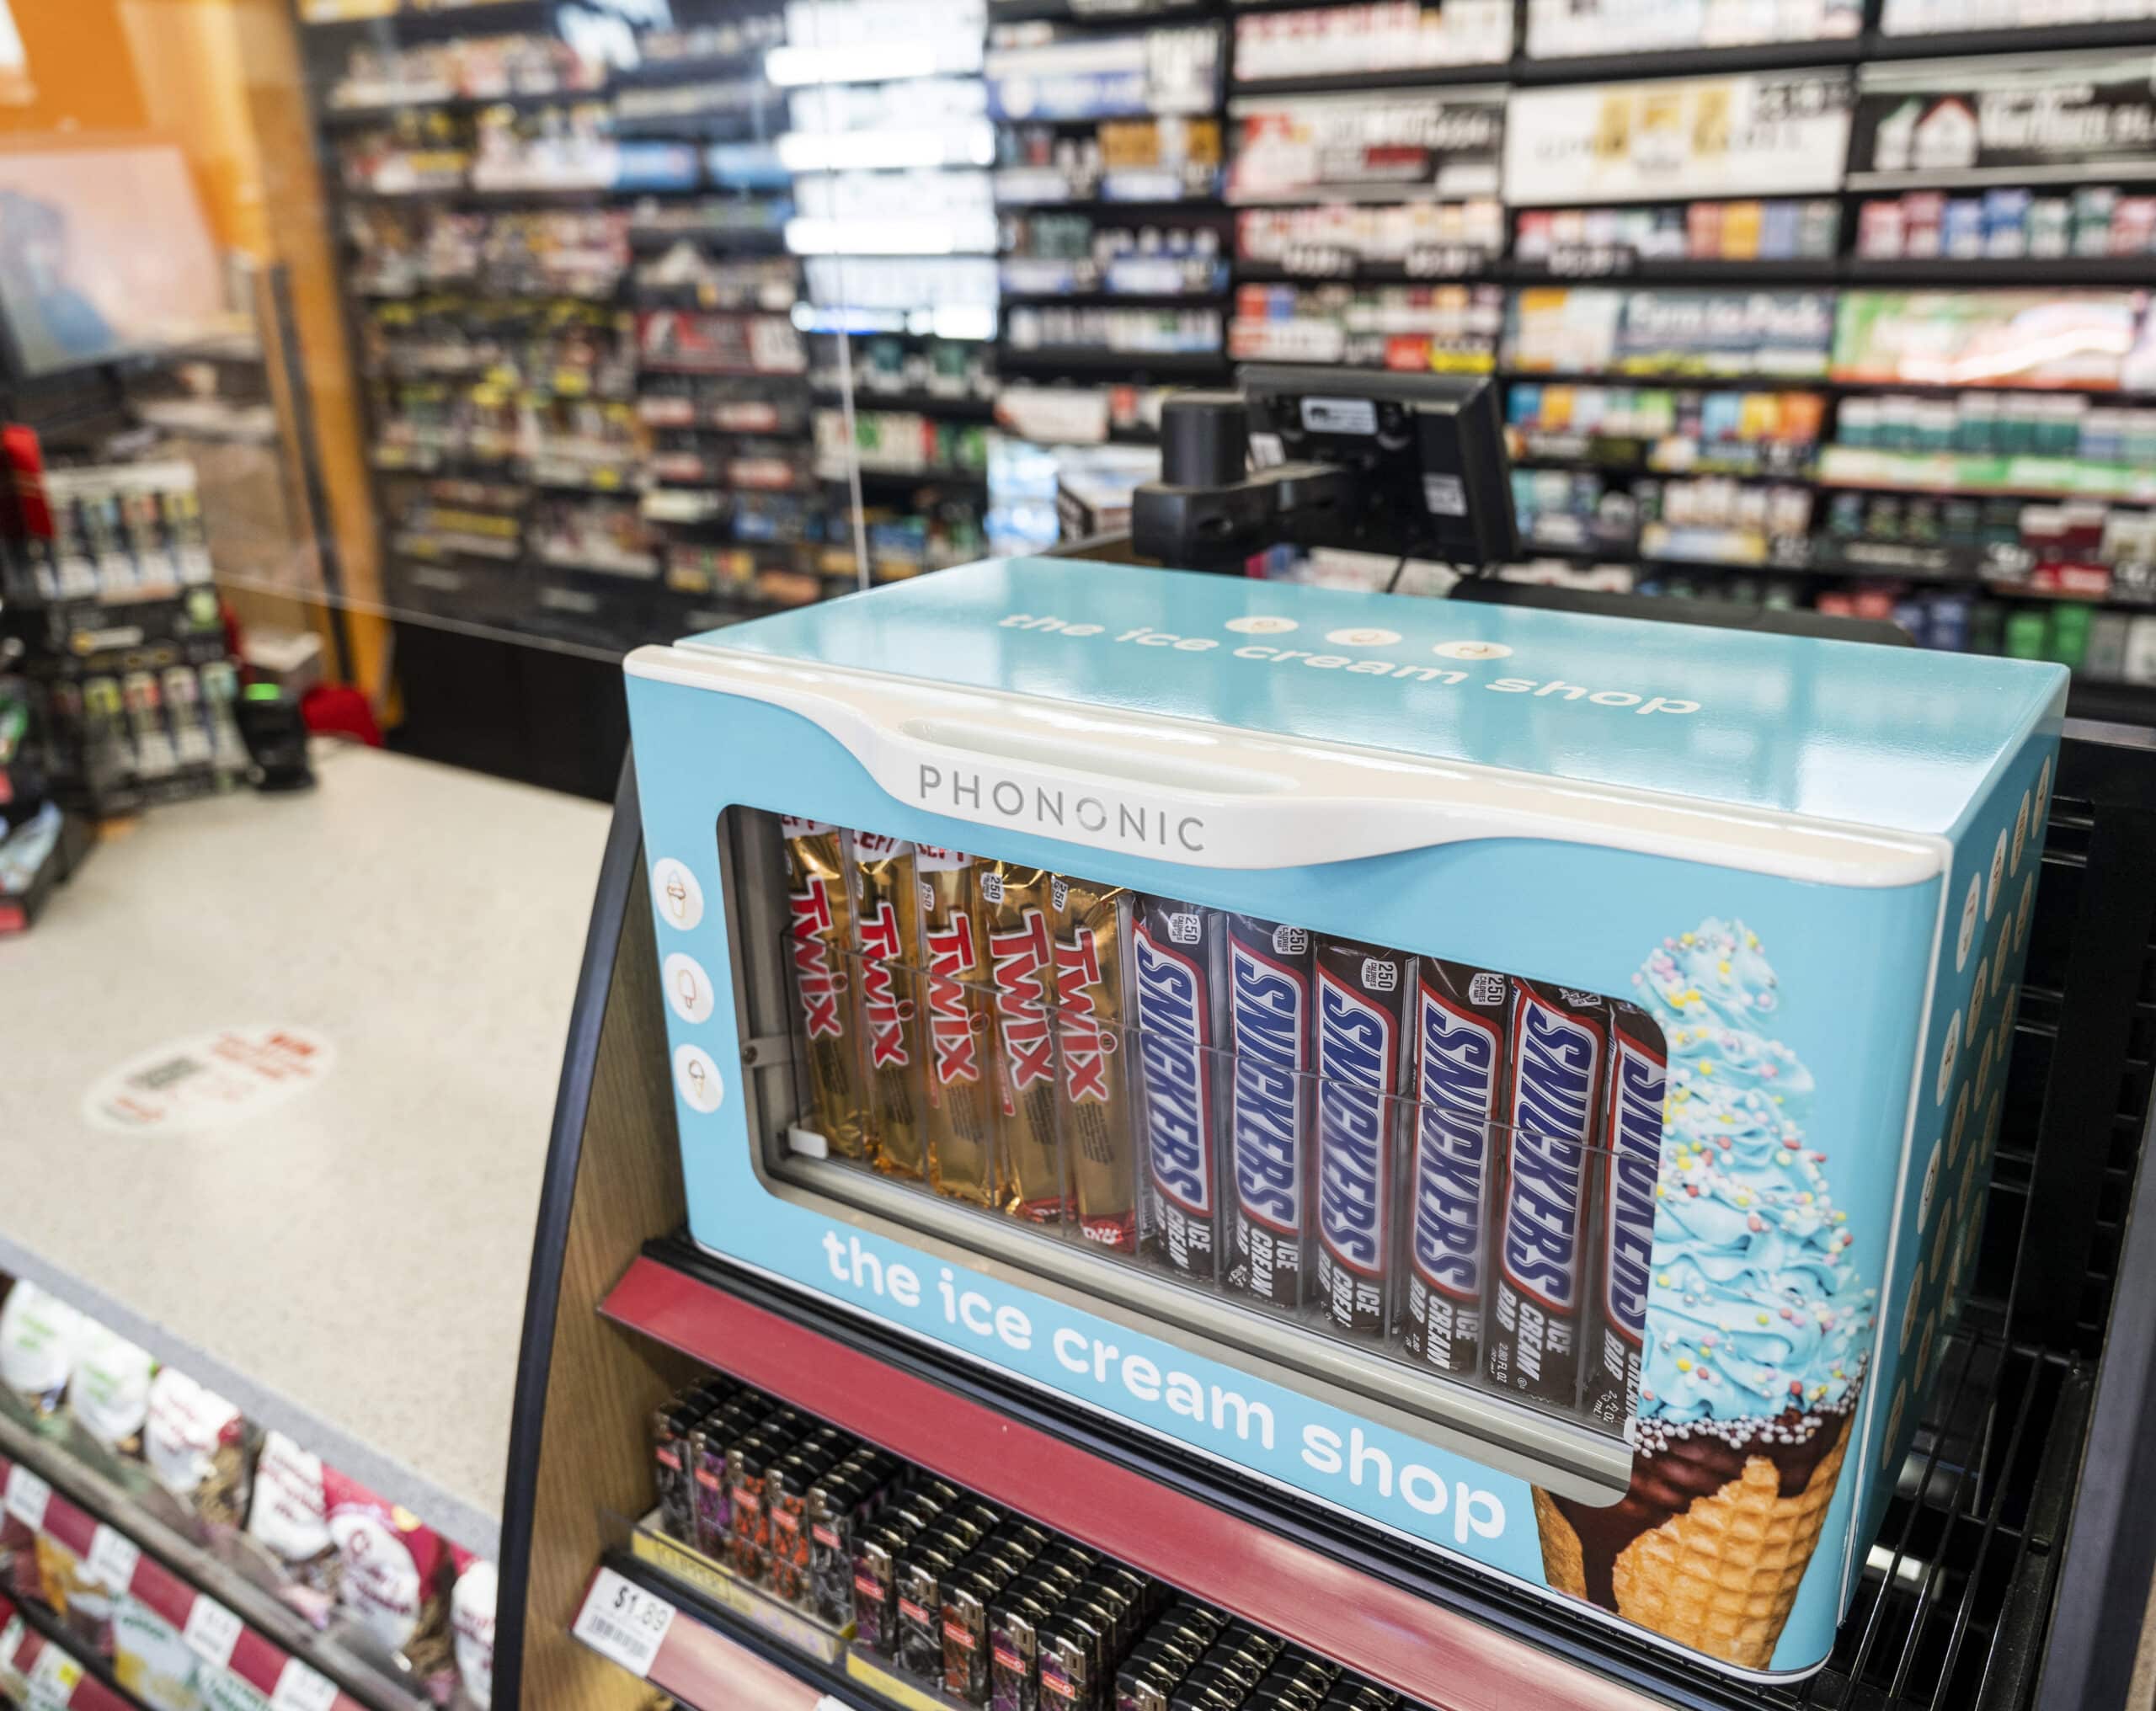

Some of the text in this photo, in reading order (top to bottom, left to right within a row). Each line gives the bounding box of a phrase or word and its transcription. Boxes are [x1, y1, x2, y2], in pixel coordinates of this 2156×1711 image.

[998, 615, 1701, 715] the ice cream shop
[920, 764, 1204, 851] PHONONIC
[990, 876, 1001, 900] 250
[1184, 916, 1198, 942] 250
[1290, 928, 1305, 952] 250
[1378, 963, 1394, 989] 250
[1488, 977, 1503, 1003] 250
[1137, 940, 1203, 1204] SNICKERS
[1235, 952, 1296, 1222] SNICKERS
[1321, 984, 1383, 1264] SNICKERS
[1415, 1002, 1491, 1293] SNICKERS
[1503, 1002, 1592, 1301] SNICKERS
[1187, 1220, 1211, 1253] ICE
[1251, 1228, 1273, 1298] CREAM
[1276, 1239, 1299, 1272] ICE
[1356, 1282, 1380, 1317] ICE
[1410, 1273, 1427, 1325] BAR
[1456, 1309, 1479, 1342] ICE
[1496, 1279, 1517, 1332] BAR
[1427, 1295, 1453, 1370] CREAM
[1516, 1302, 1545, 1382] CREAM
[1546, 1318, 1572, 1357] ICE
[1604, 1328, 1625, 1382] BAR
[822, 1230, 1506, 1544] the ice cream shop
